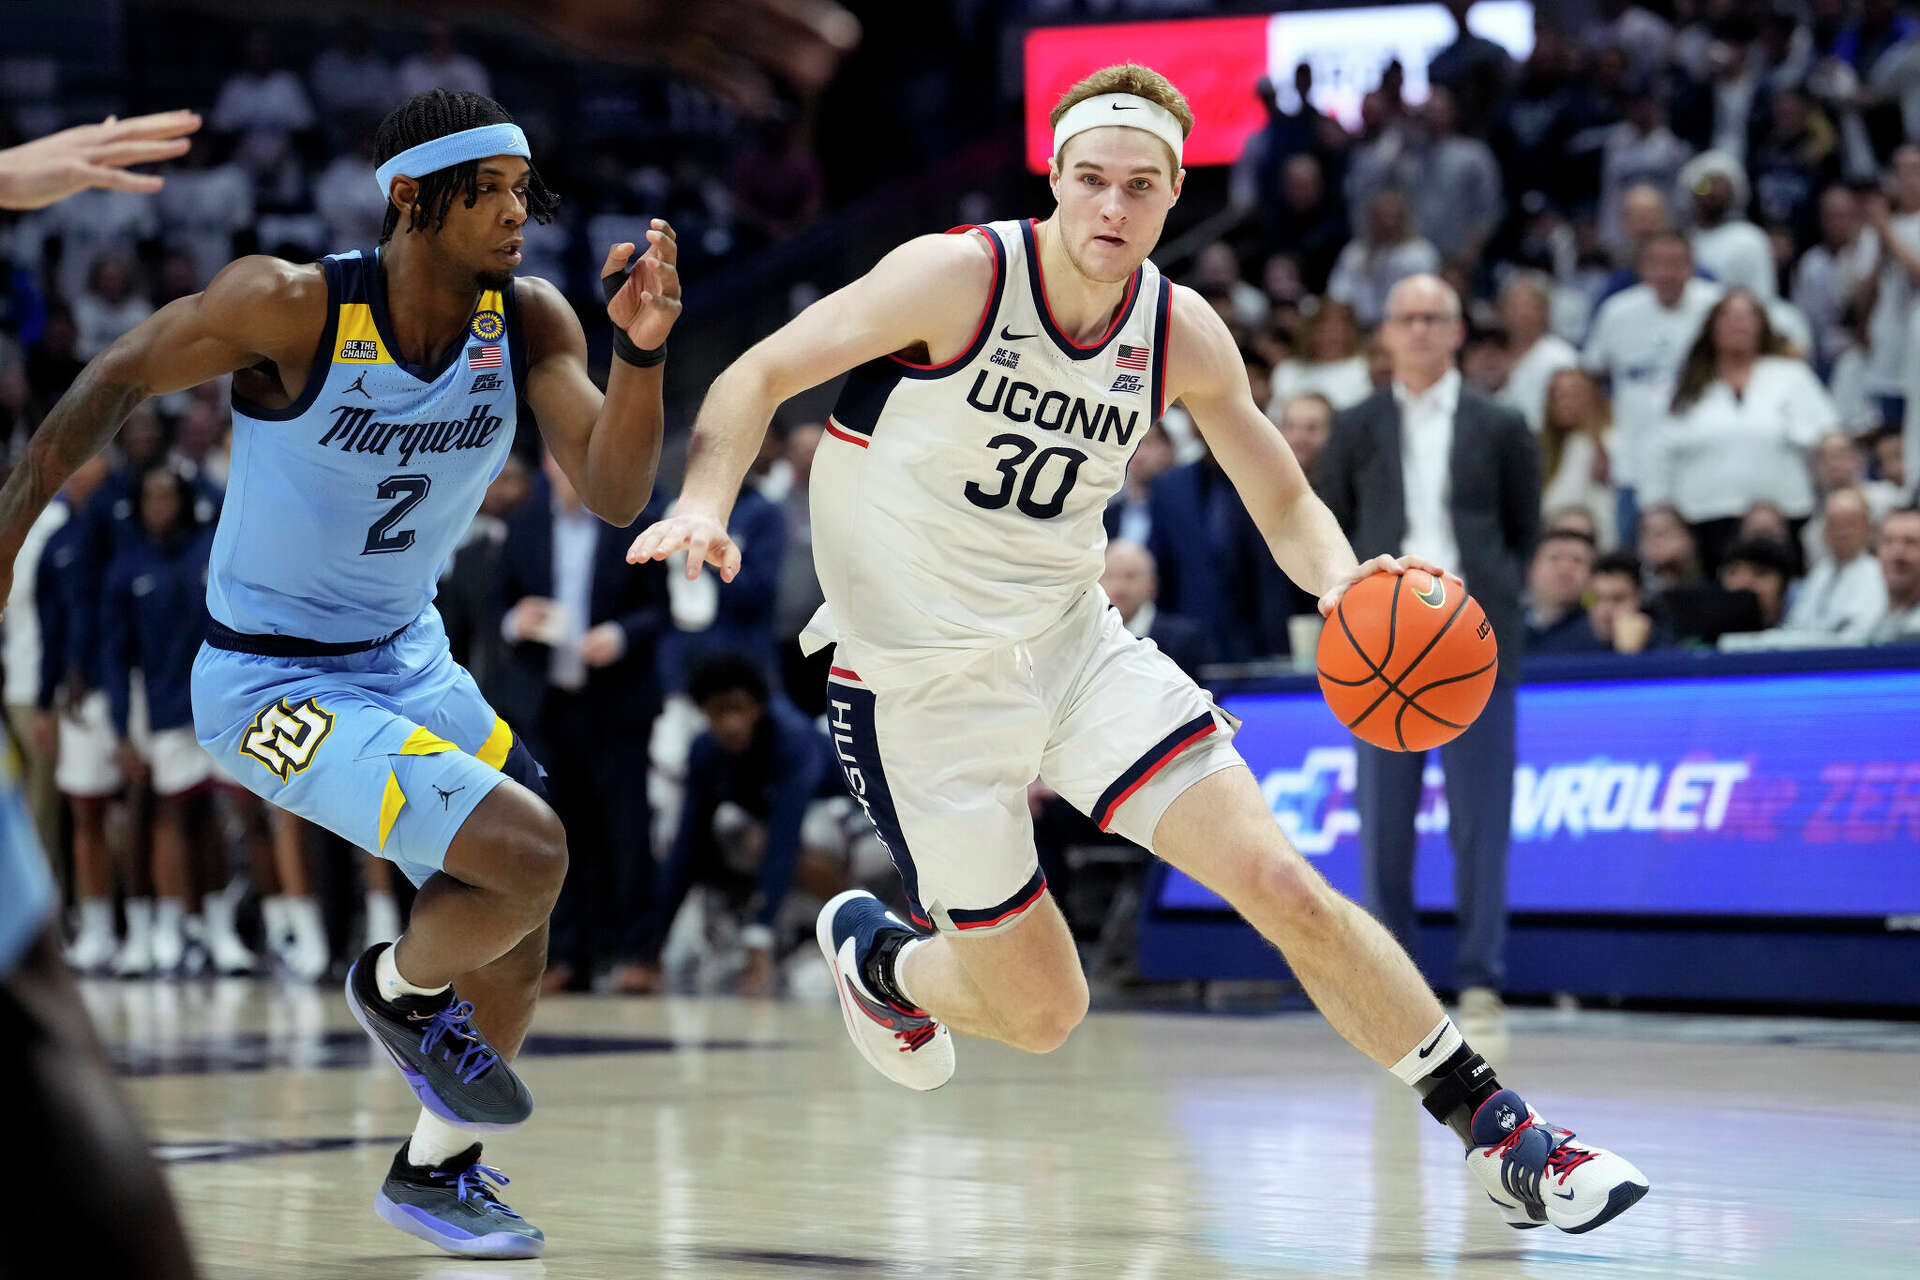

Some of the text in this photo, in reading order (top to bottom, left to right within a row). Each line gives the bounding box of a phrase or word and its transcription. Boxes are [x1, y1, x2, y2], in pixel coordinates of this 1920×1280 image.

[346, 341, 376, 350] BE THE
[341, 350, 377, 359] CHANGE
[996, 347, 1021, 361] BE THE
[990, 355, 1018, 369] CHANGE
[472, 380, 504, 391] EAST
[1117, 374, 1140, 383] BIG
[1112, 381, 1144, 391] EAST
[966, 368, 1139, 446] UCONN
[318, 404, 503, 467] Marquette
[964, 433, 1088, 519] 30
[360, 474, 431, 556] 2
